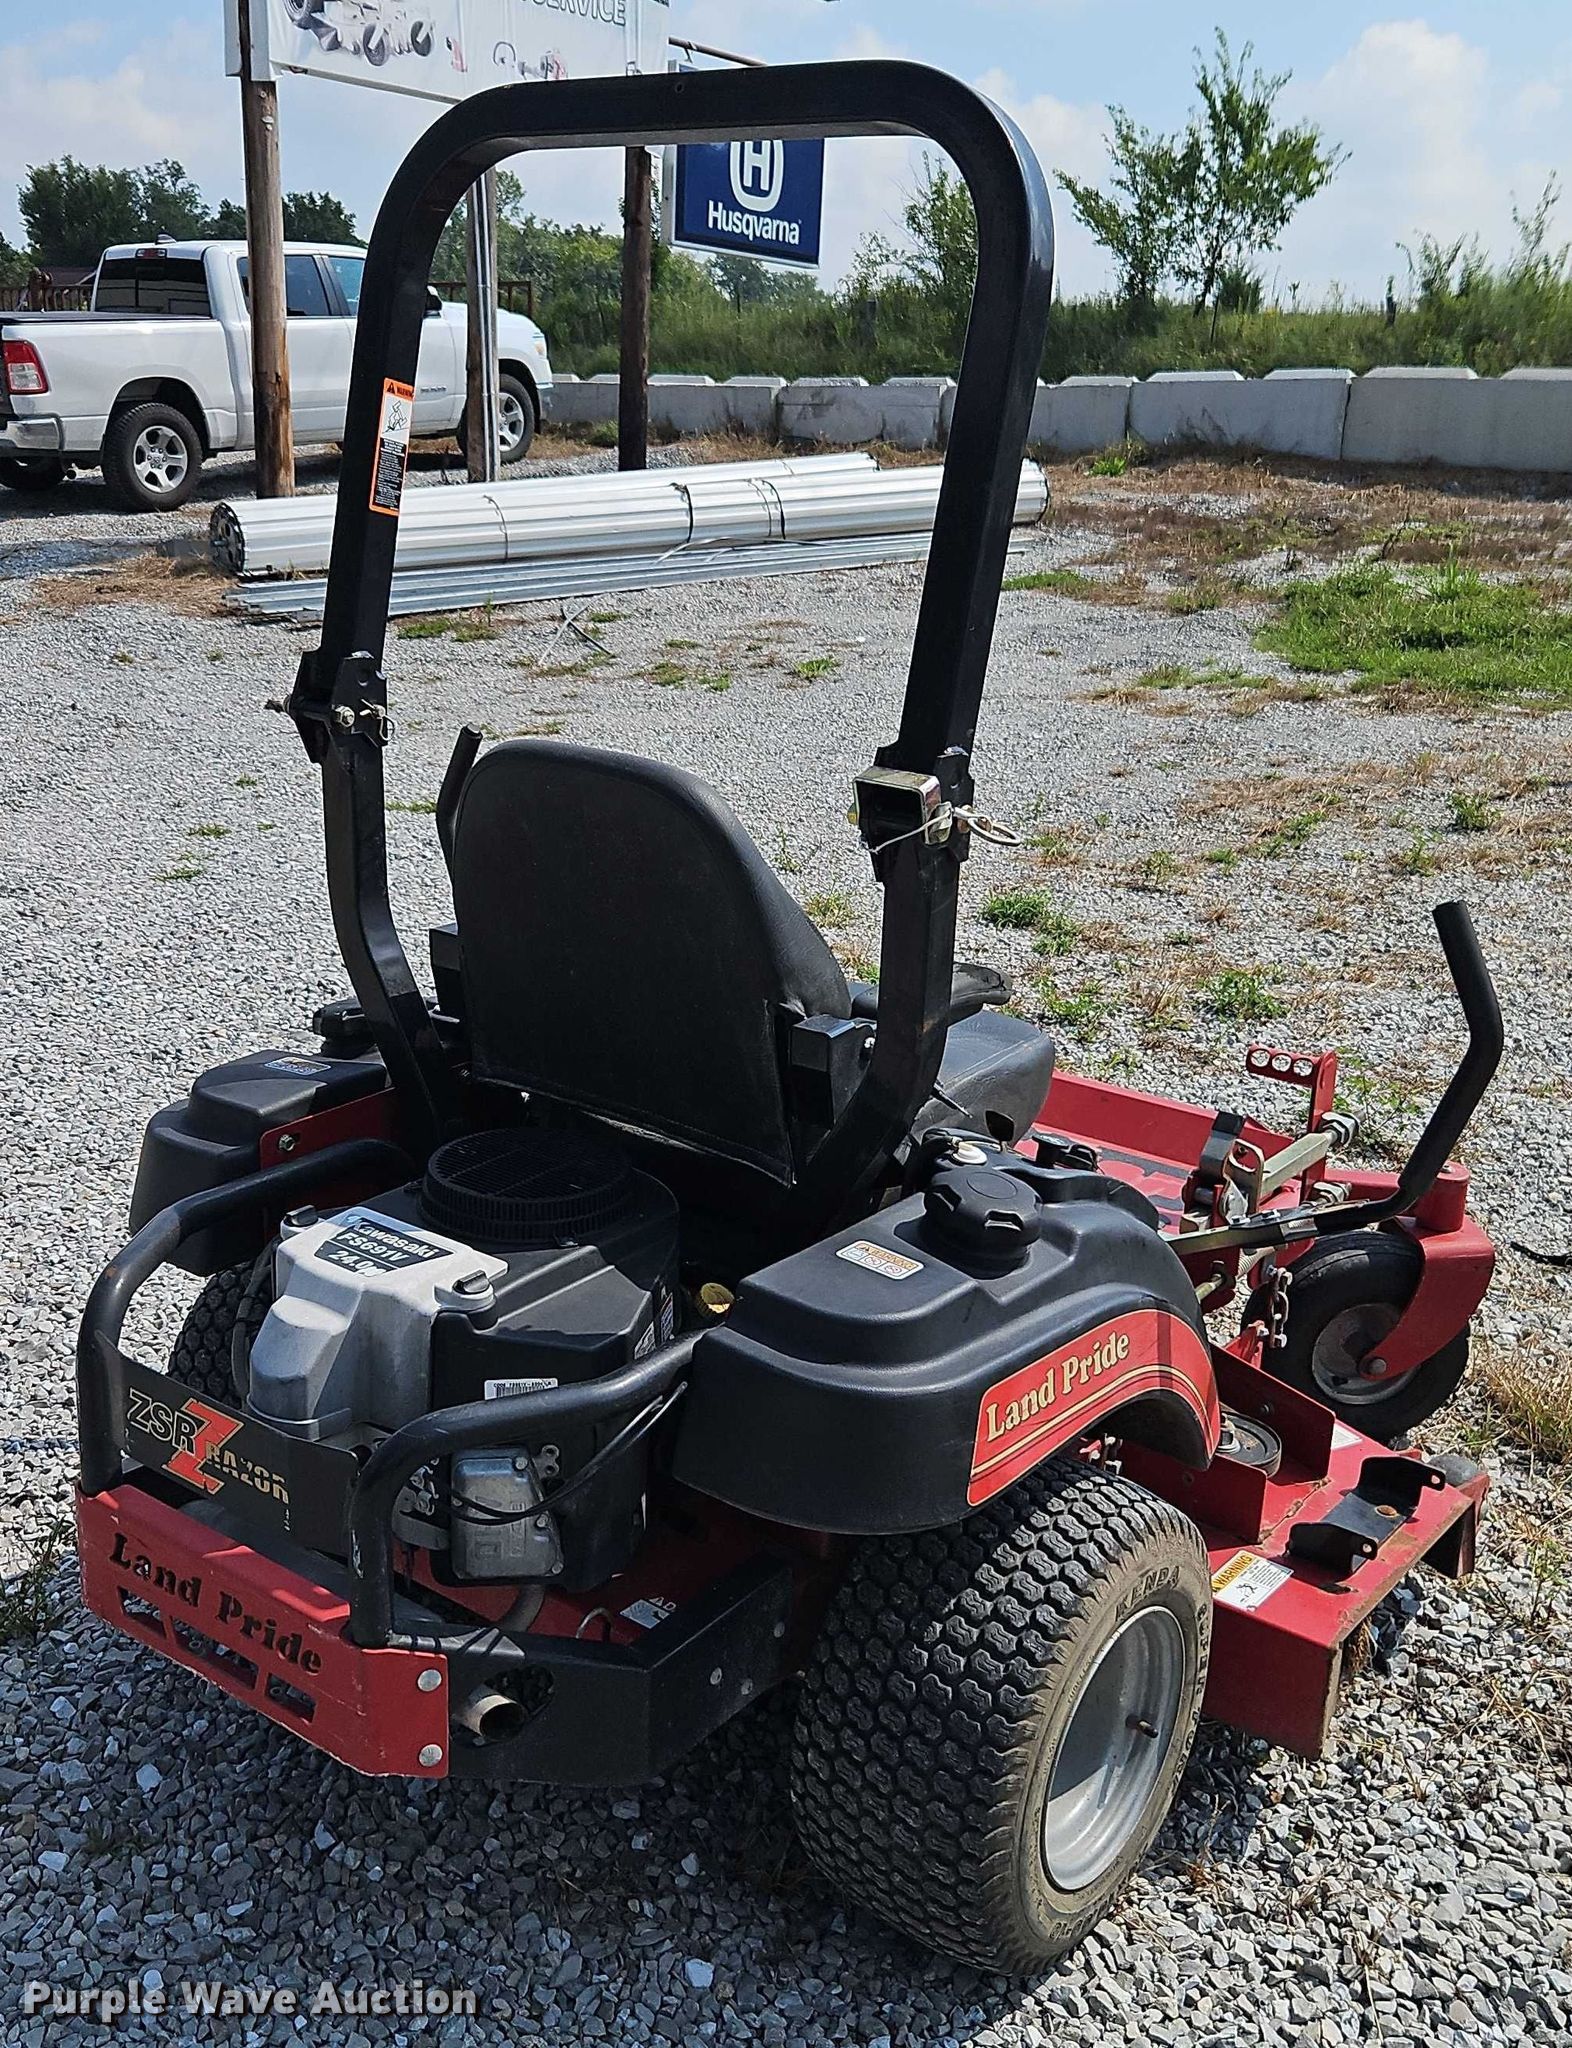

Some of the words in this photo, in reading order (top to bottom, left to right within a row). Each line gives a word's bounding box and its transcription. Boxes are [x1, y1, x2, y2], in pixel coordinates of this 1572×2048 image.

[531, 0, 626, 26] RVICE
[708, 200, 800, 245] Husqvarna
[336, 1231, 410, 1262] FS691V
[354, 1221, 440, 1258] Kawasaki
[986, 1368, 1055, 1442] Land
[1061, 1331, 1130, 1395] Pride
[127, 1386, 198, 1457] ZSR
[205, 1440, 290, 1505] RAZOR
[1219, 1554, 1253, 1586] WARNING
[109, 1532, 203, 1608] Land
[214, 1591, 322, 1676] Pride
[1116, 1565, 1180, 1622] KENDA
